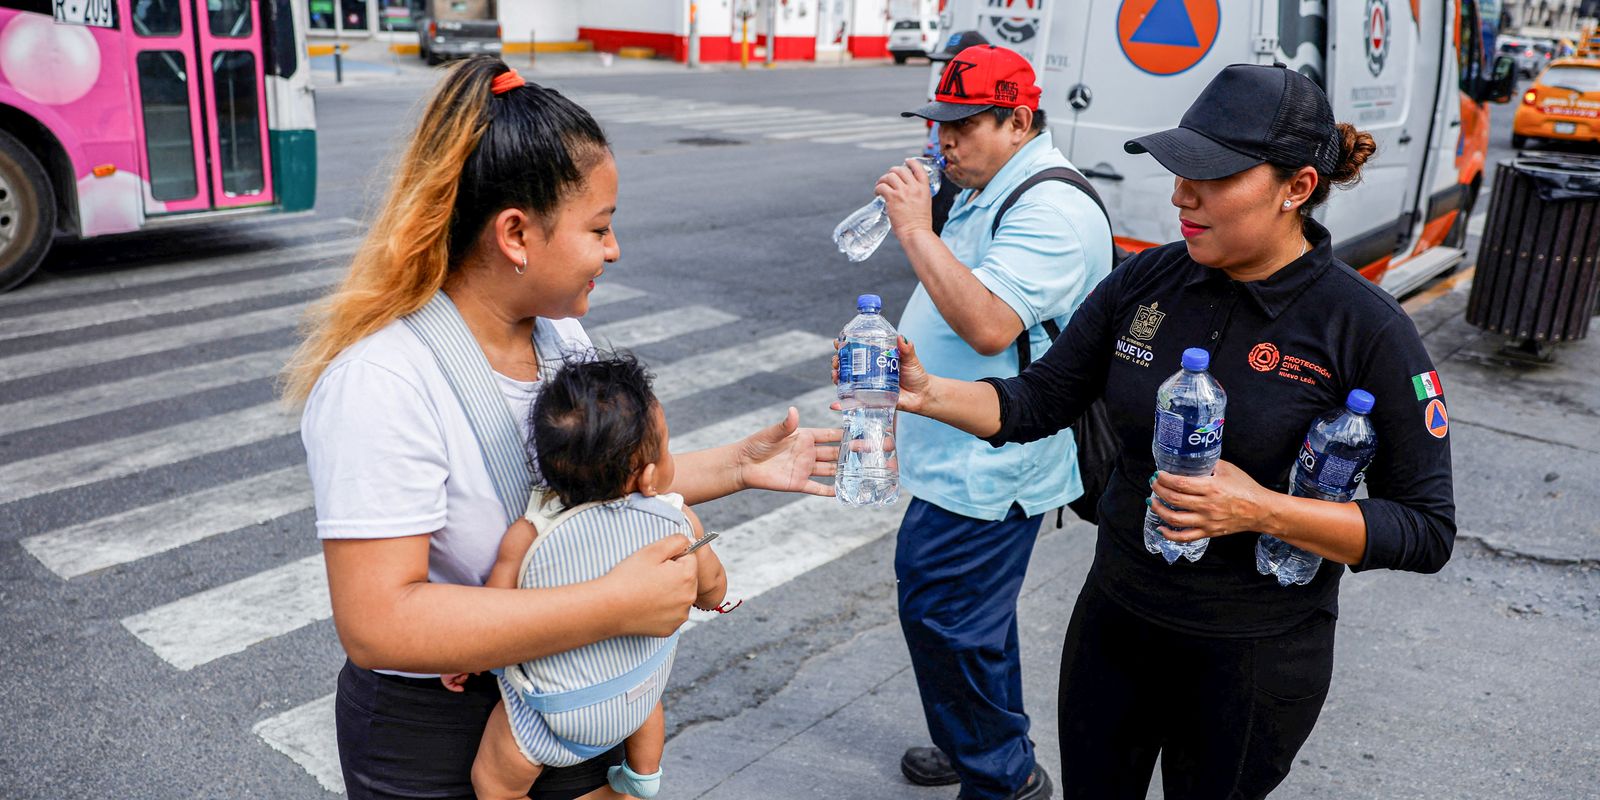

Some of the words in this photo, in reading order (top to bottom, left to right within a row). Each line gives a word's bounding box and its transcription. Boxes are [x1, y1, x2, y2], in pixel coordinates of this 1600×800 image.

[1116, 339, 1154, 362] NUEVO
[1282, 361, 1301, 371] CIVIL
[1283, 355, 1332, 379] PROTECCIÓN
[1278, 370, 1299, 380] NUEVO
